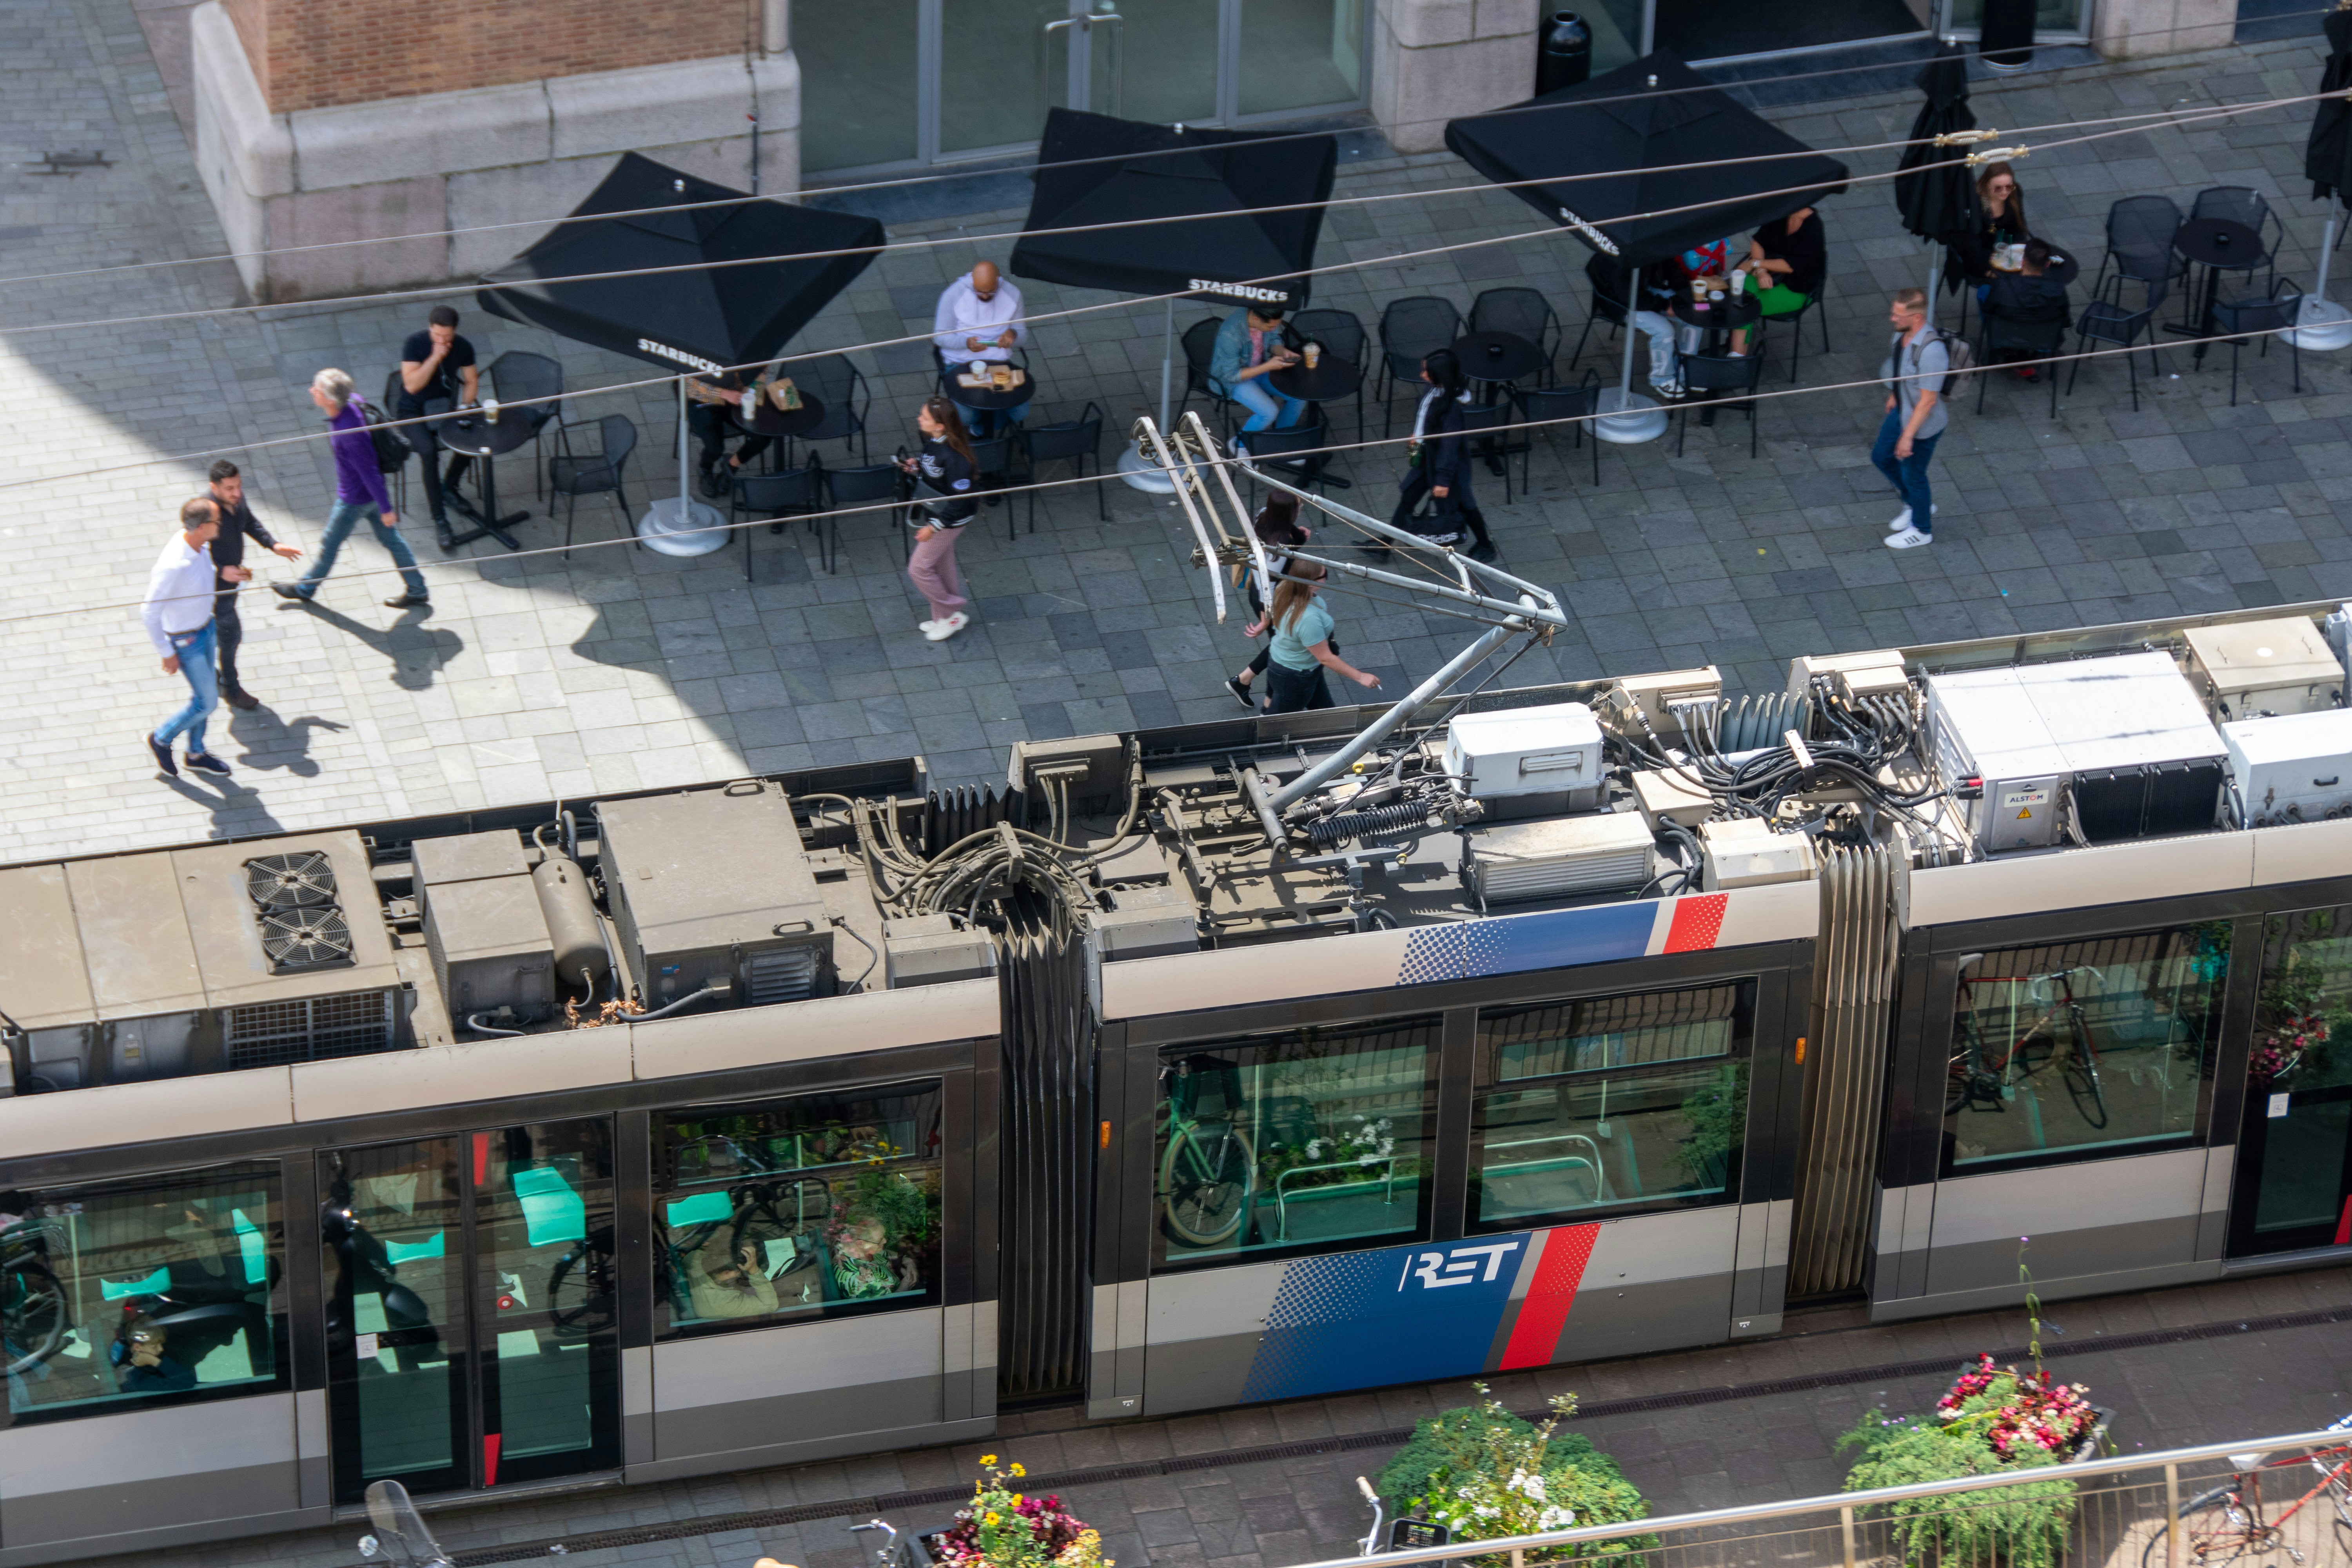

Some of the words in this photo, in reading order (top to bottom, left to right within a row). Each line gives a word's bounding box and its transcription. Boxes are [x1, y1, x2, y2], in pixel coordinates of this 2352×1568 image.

[1559, 207, 1620, 256] STARBUCKS
[1188, 279, 1289, 302] STARBUCKS
[638, 338, 723, 378] STARBUCKS
[2009, 794, 2043, 803] ALSTOM
[1415, 1242, 1519, 1289] RET
